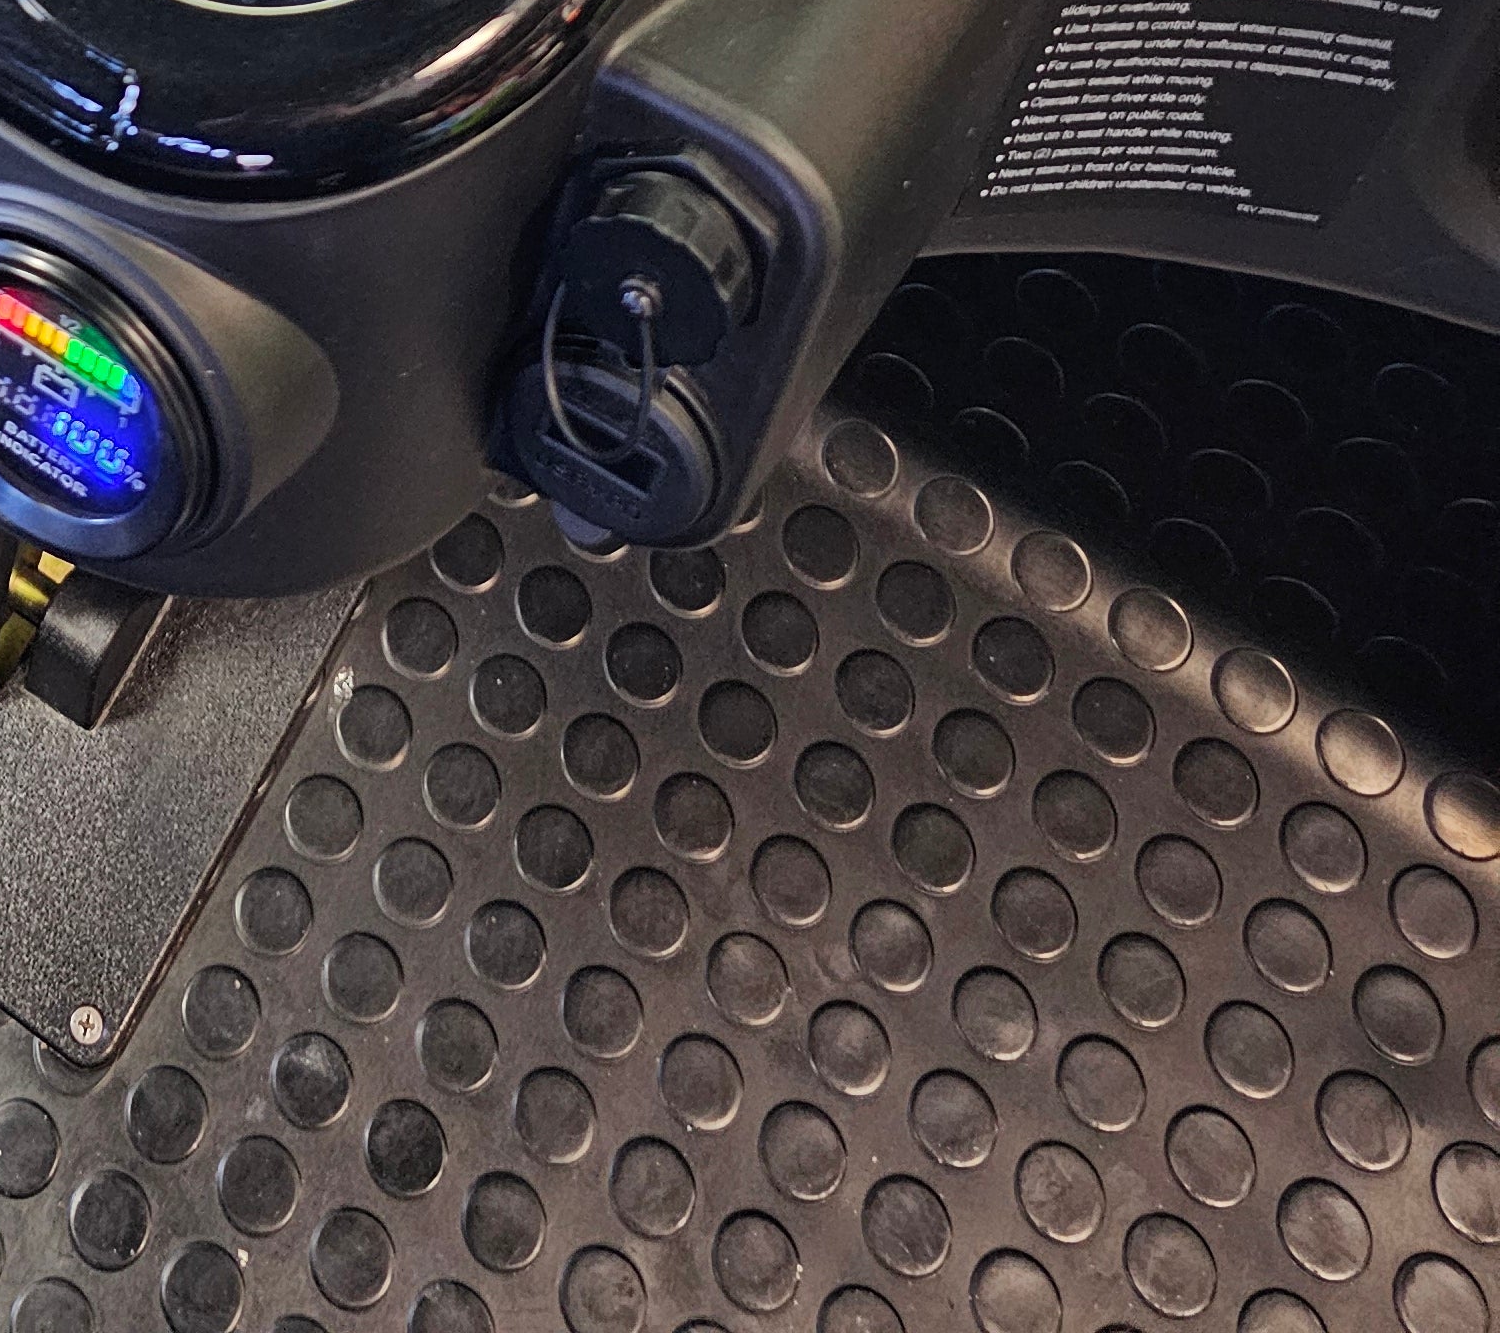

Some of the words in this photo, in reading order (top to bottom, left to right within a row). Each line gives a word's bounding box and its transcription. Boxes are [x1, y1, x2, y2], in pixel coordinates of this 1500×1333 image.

[1151, 20, 1196, 31] control
[1132, 74, 1164, 86] while
[1112, 93, 1147, 103] driver
[1149, 92, 1176, 103] side
[1108, 111, 1126, 121] on
[1126, 109, 1166, 122] public
[1105, 127, 1147, 138] handle
[1102, 146, 1125, 157] per
[4, 420, 82, 476] BATTERY
